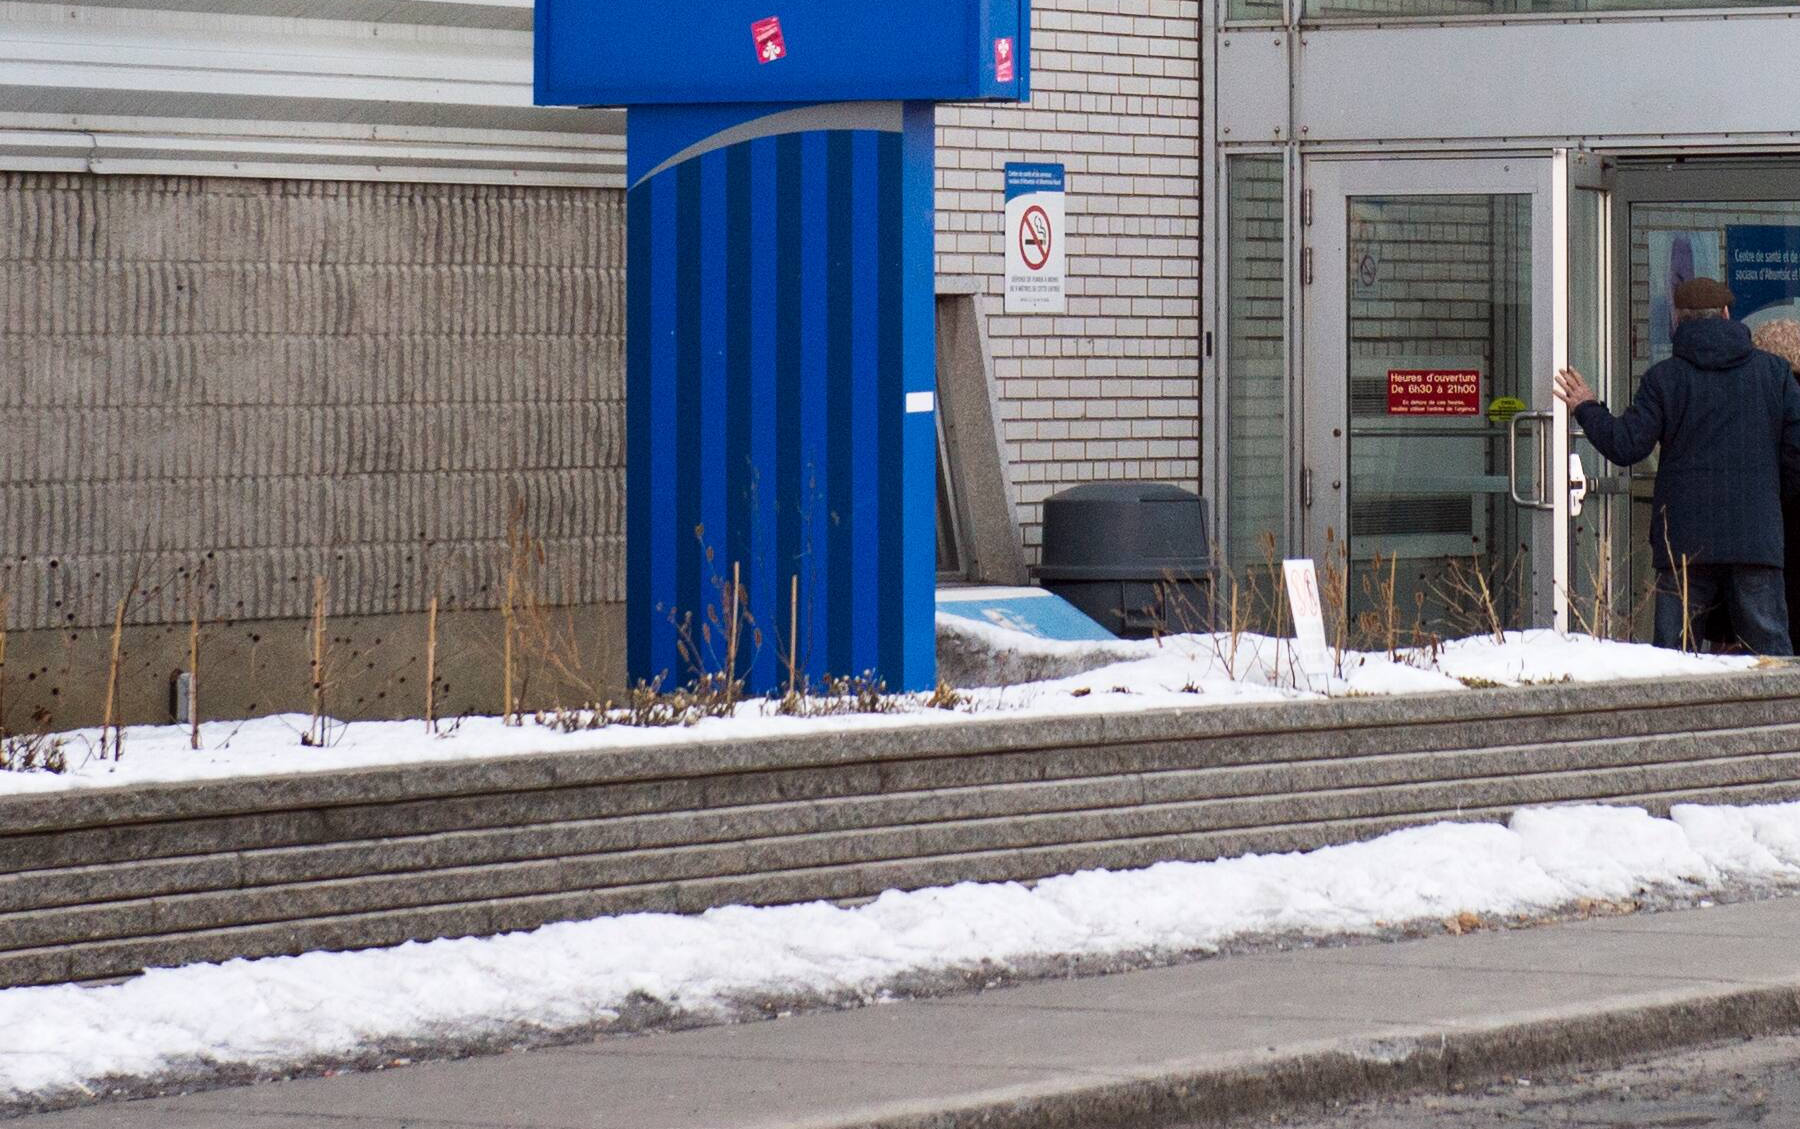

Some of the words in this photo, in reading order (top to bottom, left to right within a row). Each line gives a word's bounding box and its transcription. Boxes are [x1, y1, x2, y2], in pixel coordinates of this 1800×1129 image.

[1734, 248, 1755, 263] Centre
[1755, 250, 1764, 263] de
[1764, 249, 1782, 263] santé
[1783, 250, 1790, 263] et
[1790, 249, 1799, 264] de
[1735, 268, 1758, 281] sociaux
[1791, 268, 1799, 281] et
[1390, 373, 1422, 383] Heures
[1426, 373, 1477, 383] d'ouverture
[1390, 384, 1404, 394] De
[1408, 384, 1433, 394] 6h30
[1436, 384, 1443, 394] à
[1447, 384, 1477, 394] 21h00
